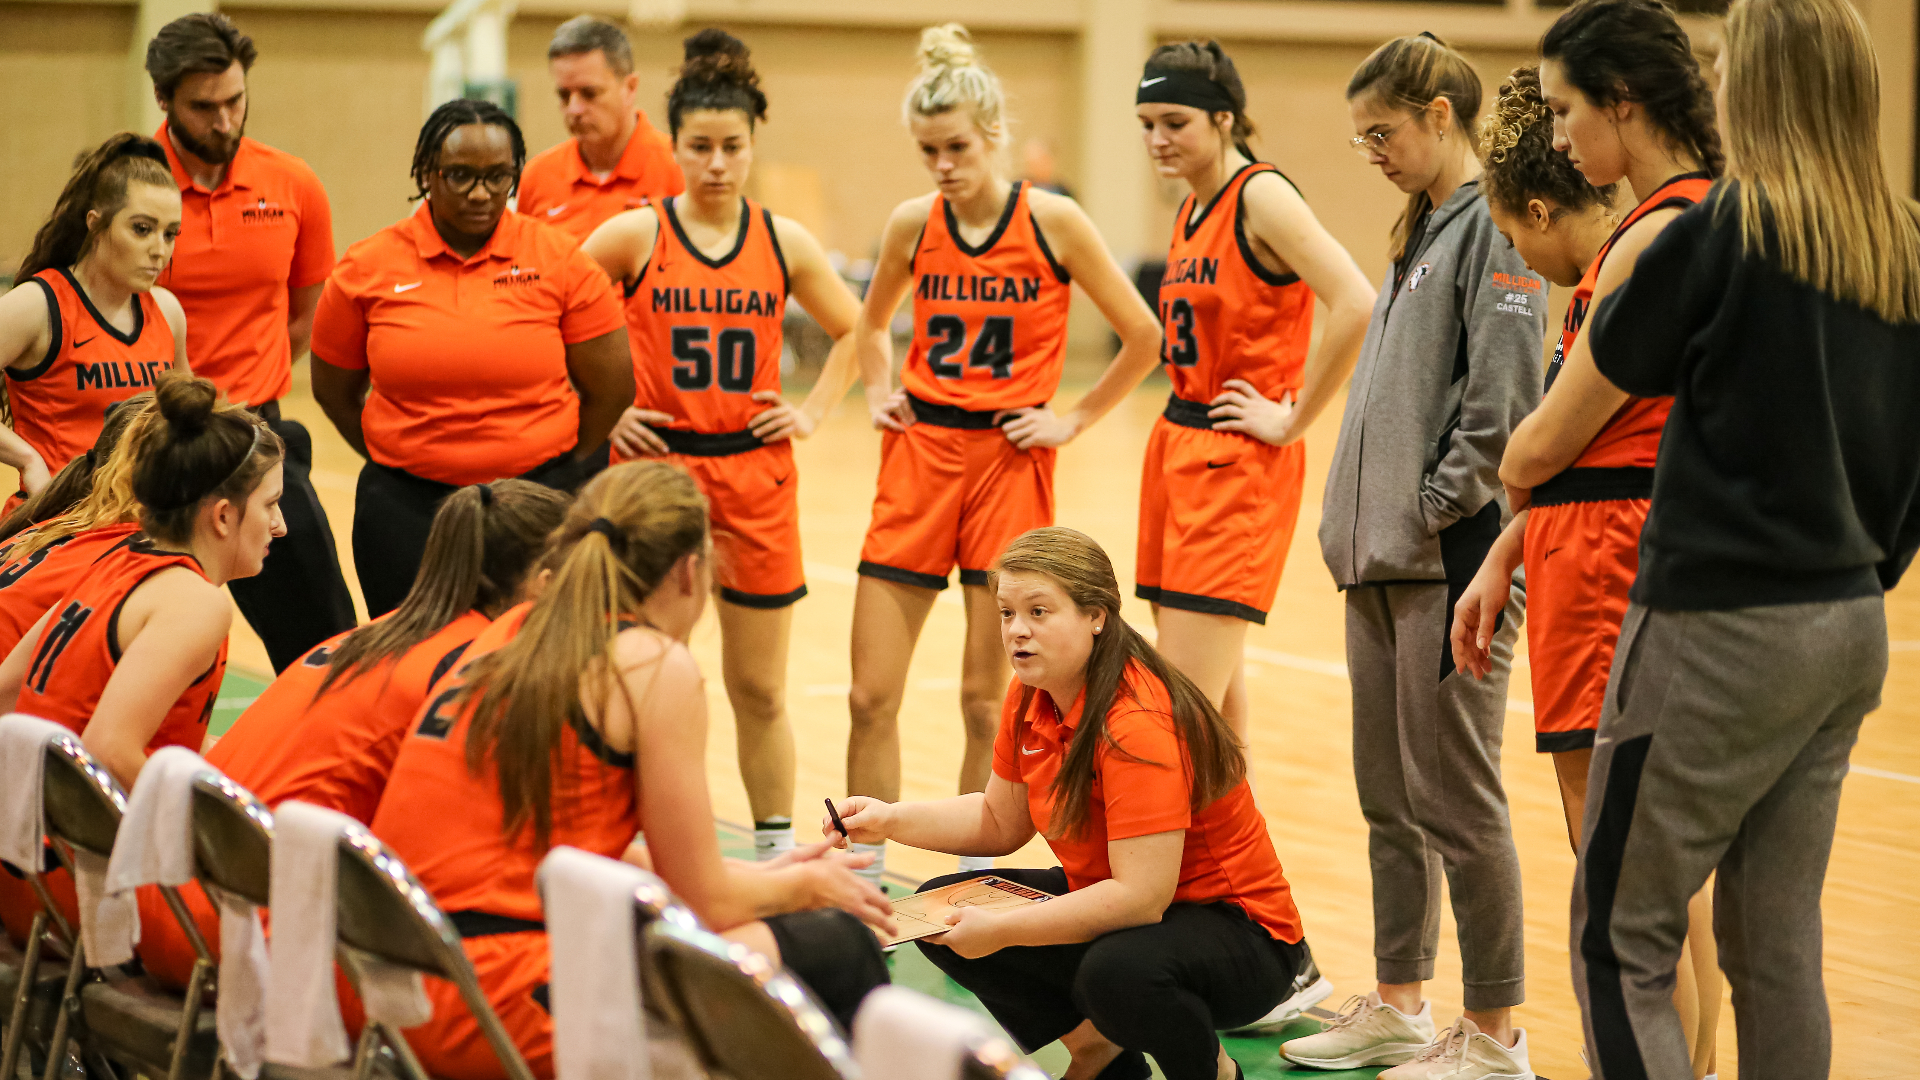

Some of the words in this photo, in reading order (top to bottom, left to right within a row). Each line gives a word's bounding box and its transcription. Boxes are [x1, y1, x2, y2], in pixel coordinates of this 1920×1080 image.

[915, 273, 1041, 303] MILLIGAN
[1492, 271, 1542, 290] MILLIGAN
[651, 286, 778, 318] MILLIGAN
[1496, 302, 1533, 317] CASTELL
[1504, 292, 1529, 305] #25
[670, 325, 757, 394] 50
[926, 313, 1015, 380] 24
[26, 599, 94, 696] 11
